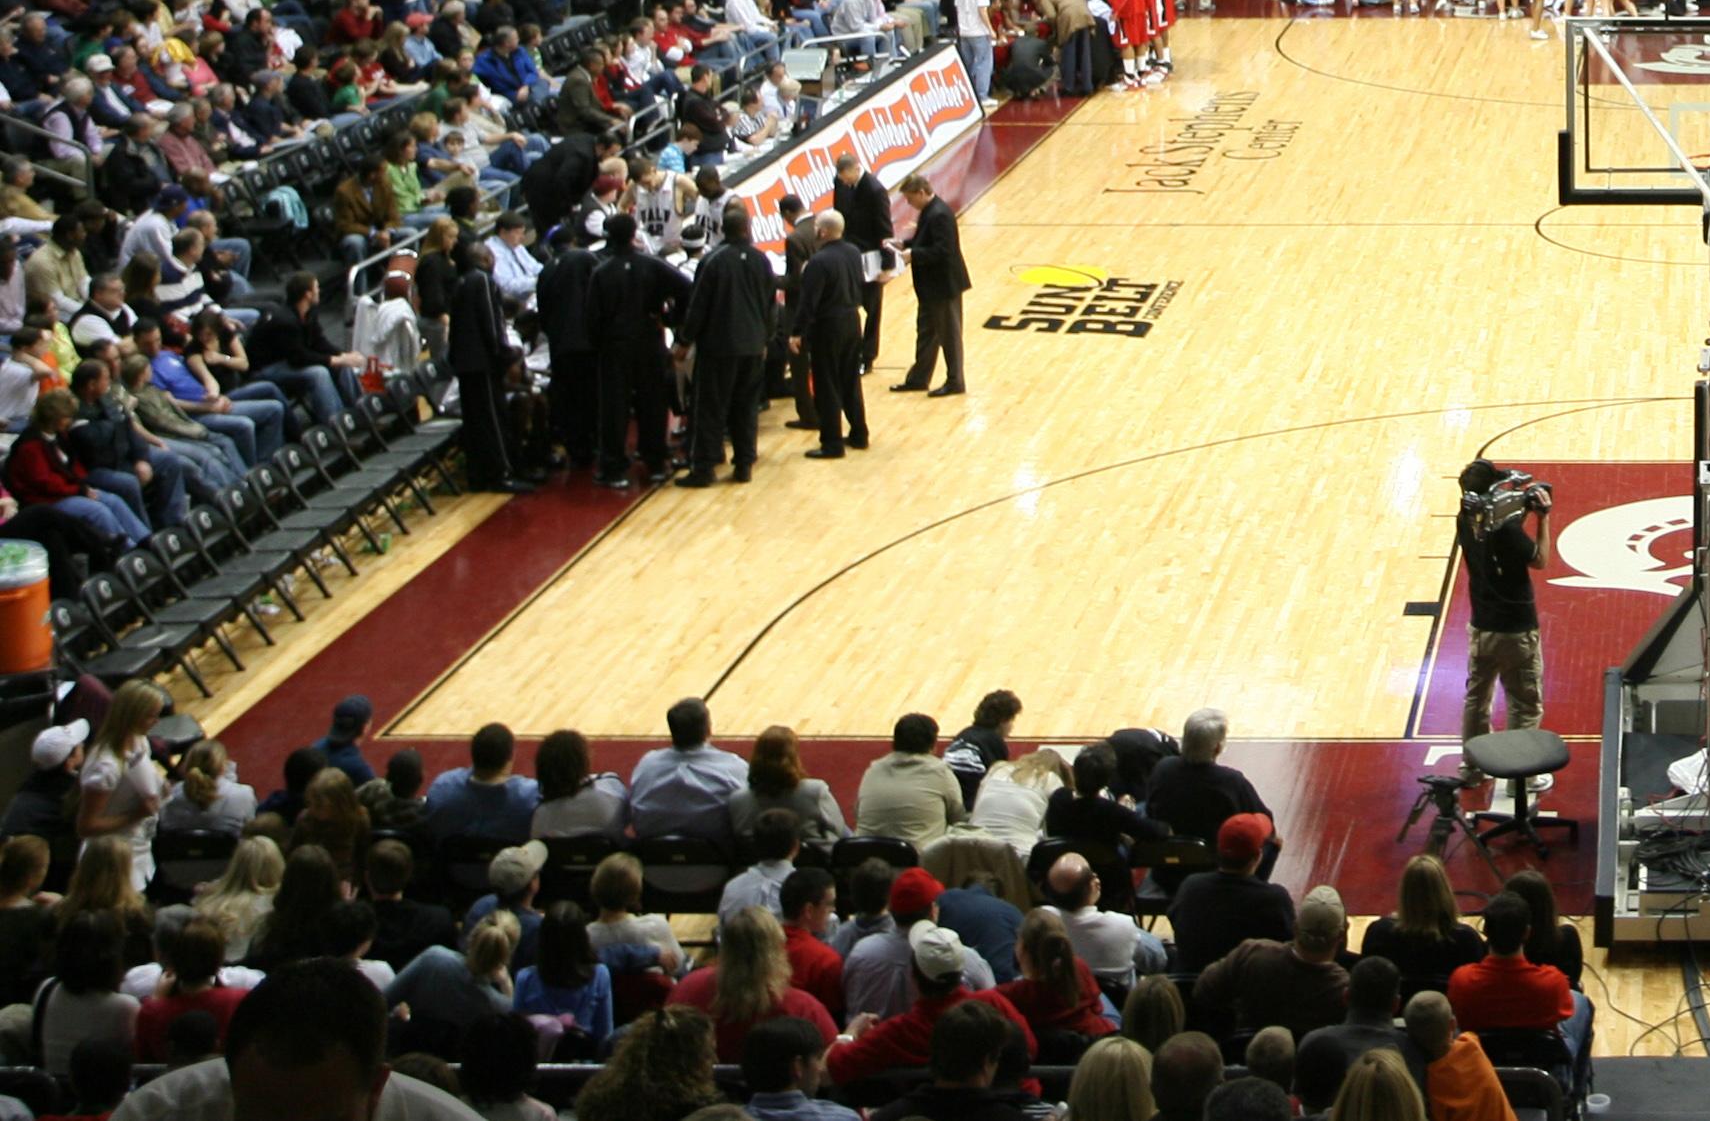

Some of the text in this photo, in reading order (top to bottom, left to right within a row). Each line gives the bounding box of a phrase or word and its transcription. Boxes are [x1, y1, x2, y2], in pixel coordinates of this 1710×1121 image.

[1103, 91, 1260, 196] Jack Stephens
[1222, 120, 1303, 160] Center
[983, 283, 1095, 335] SUN
[1066, 277, 1159, 339] BELT
